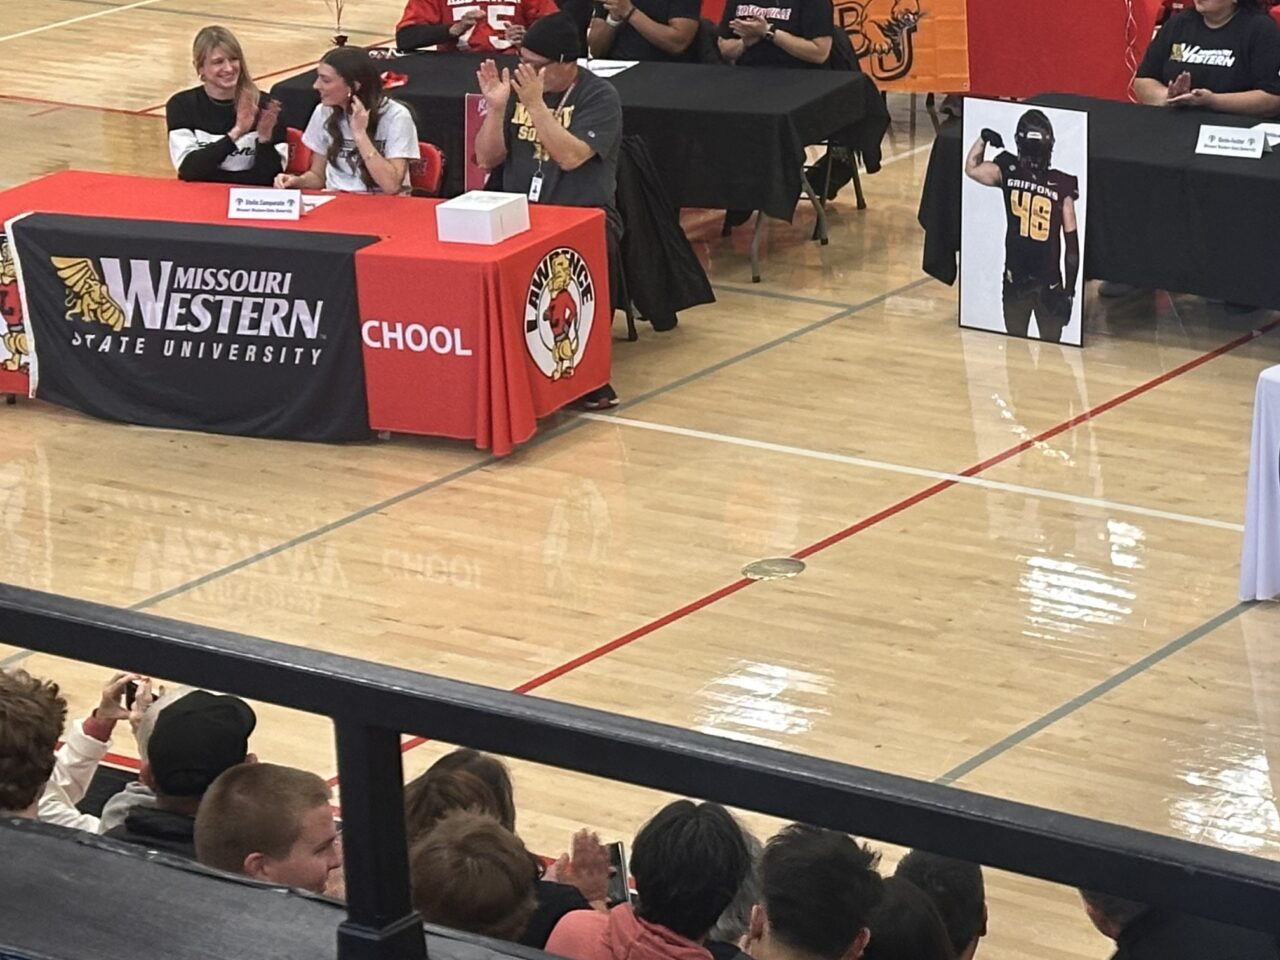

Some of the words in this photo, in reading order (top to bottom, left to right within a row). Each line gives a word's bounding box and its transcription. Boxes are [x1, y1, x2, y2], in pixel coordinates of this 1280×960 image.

[451, 4, 516, 51] 75
[1181, 42, 1236, 68] WESTERN
[1007, 178, 1059, 201] GRIFFONS
[174, 267, 292, 295] MISSOURI
[100, 257, 324, 339] WESTERN
[71, 331, 146, 354] STATE
[163, 339, 322, 366] UNIVERSITY
